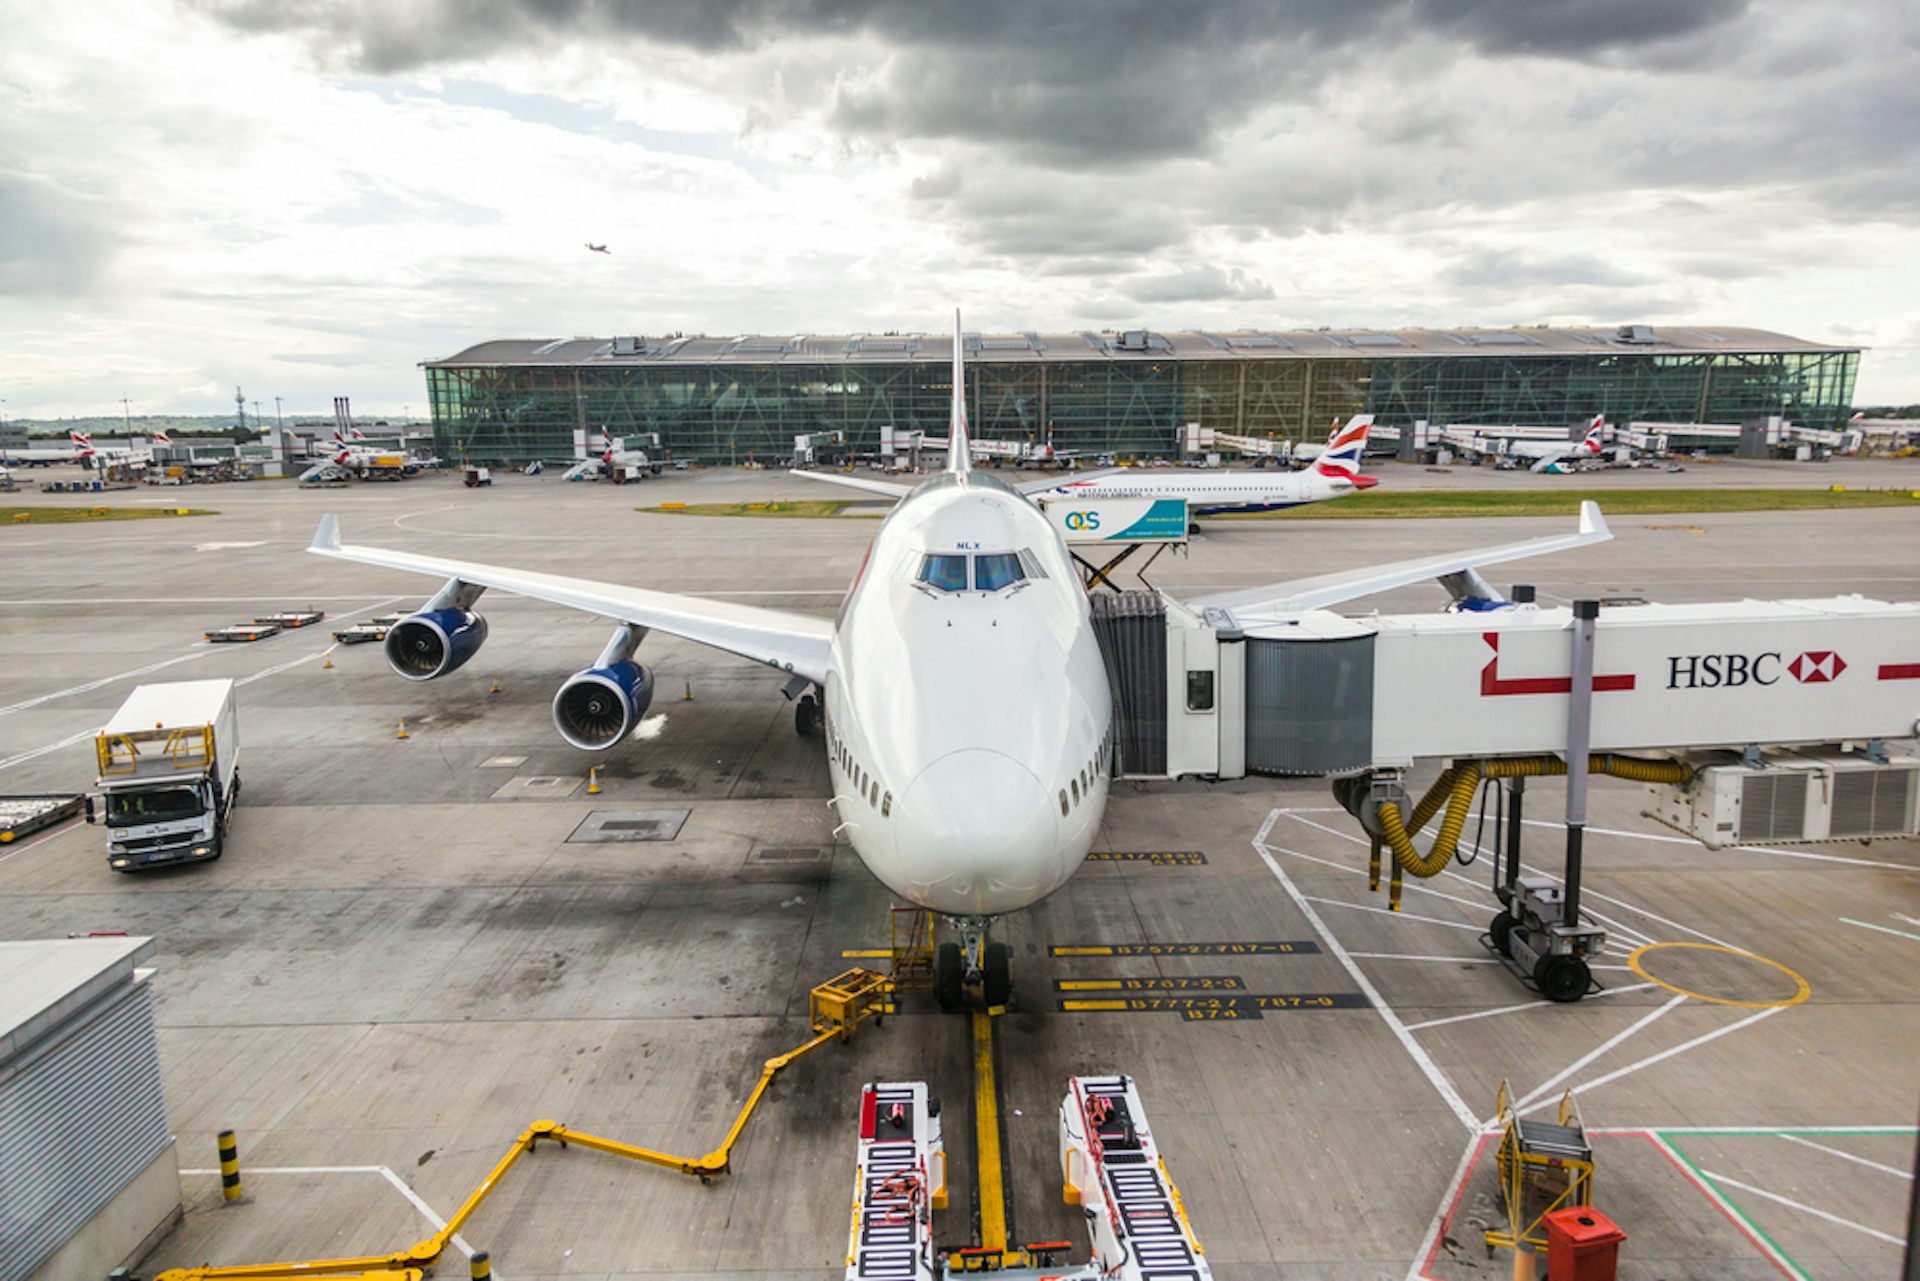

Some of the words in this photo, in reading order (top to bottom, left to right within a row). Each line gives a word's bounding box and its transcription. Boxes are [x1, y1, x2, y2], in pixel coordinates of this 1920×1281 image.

[1065, 511, 1100, 531] OCS
[956, 541, 981, 550] NLX
[1666, 652, 1781, 690] HSBC
